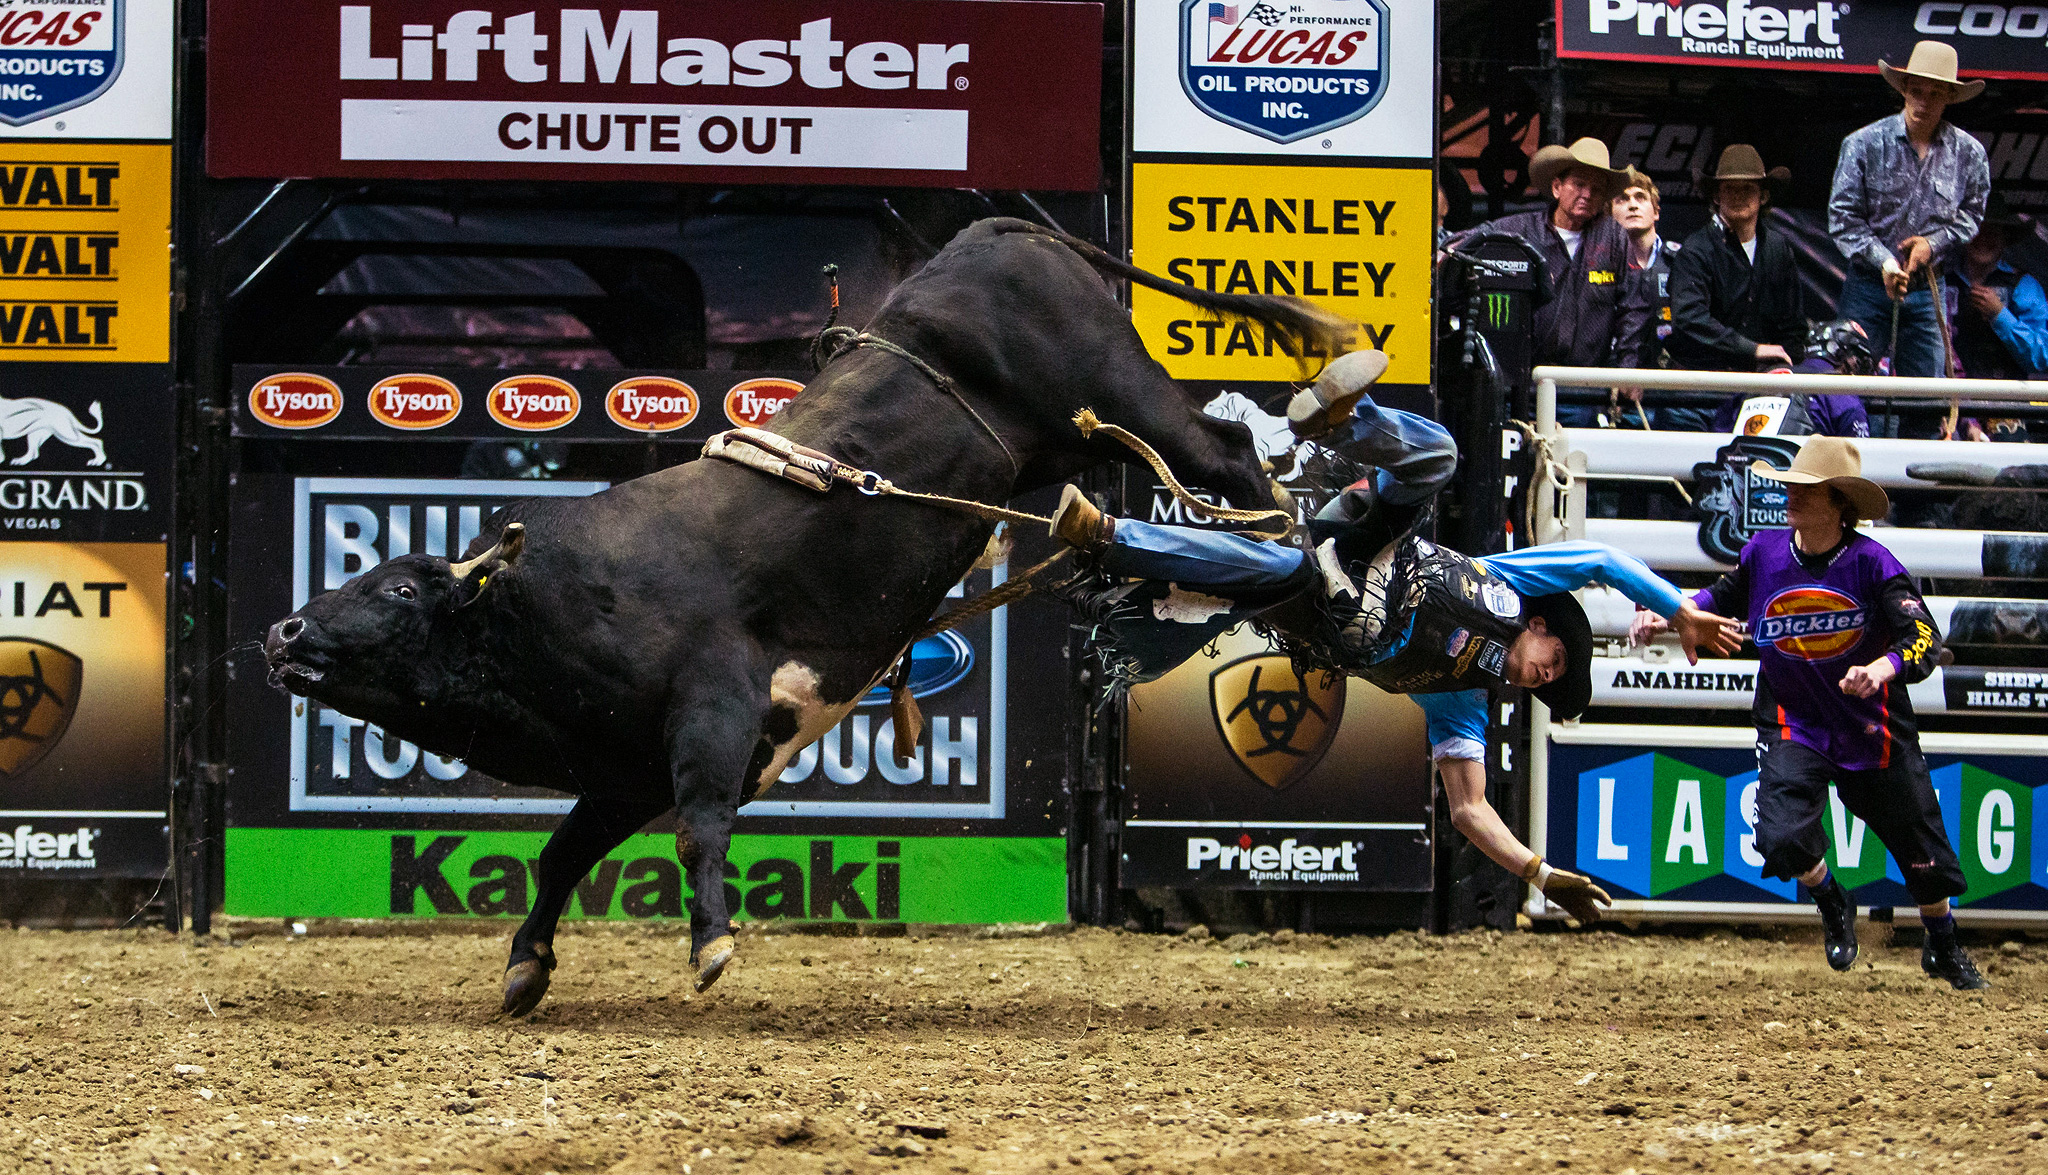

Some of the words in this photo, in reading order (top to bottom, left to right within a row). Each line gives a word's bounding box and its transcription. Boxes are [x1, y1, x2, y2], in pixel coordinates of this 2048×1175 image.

[1290, 17, 1372, 26] PERFORMANCE
[1589, 0, 1840, 44] Priefert
[1914, 2, 2048, 38] COO
[339, 5, 970, 89] LiftMaster
[1208, 28, 1368, 65] LUCAS
[1682, 37, 1740, 55] Ranch
[1746, 40, 1844, 60] Equipment
[1198, 75, 1237, 92] OIL
[1245, 76, 1370, 95] PRODUCTS
[1262, 102, 1309, 119] INC.
[498, 112, 681, 153] CHUTE
[698, 115, 813, 156] OUT
[1168, 196, 1397, 235] STANLEY
[1167, 258, 1396, 297] STANLEY
[261, 386, 334, 416] Tyson
[380, 386, 453, 417] Tyson
[499, 387, 572, 419] Tyson
[618, 389, 690, 420] Tyson
[736, 390, 792, 421] Tys
[0, 479, 146, 510] GRAND
[1151, 493, 1248, 524] MG
[4, 517, 62, 530] VEGAS
[1750, 508, 1788, 524] TOUG
[325, 504, 503, 590] BUI
[0, 582, 127, 617] IAT
[1766, 611, 1865, 637] Dickies
[1611, 671, 1755, 692] ANAHEIM
[1967, 691, 2031, 707] HILLS
[777, 715, 978, 785] UGH
[1187, 834, 1358, 872] Priefert
[1249, 870, 1289, 880] Ranch
[1293, 870, 1360, 883] Equipment
